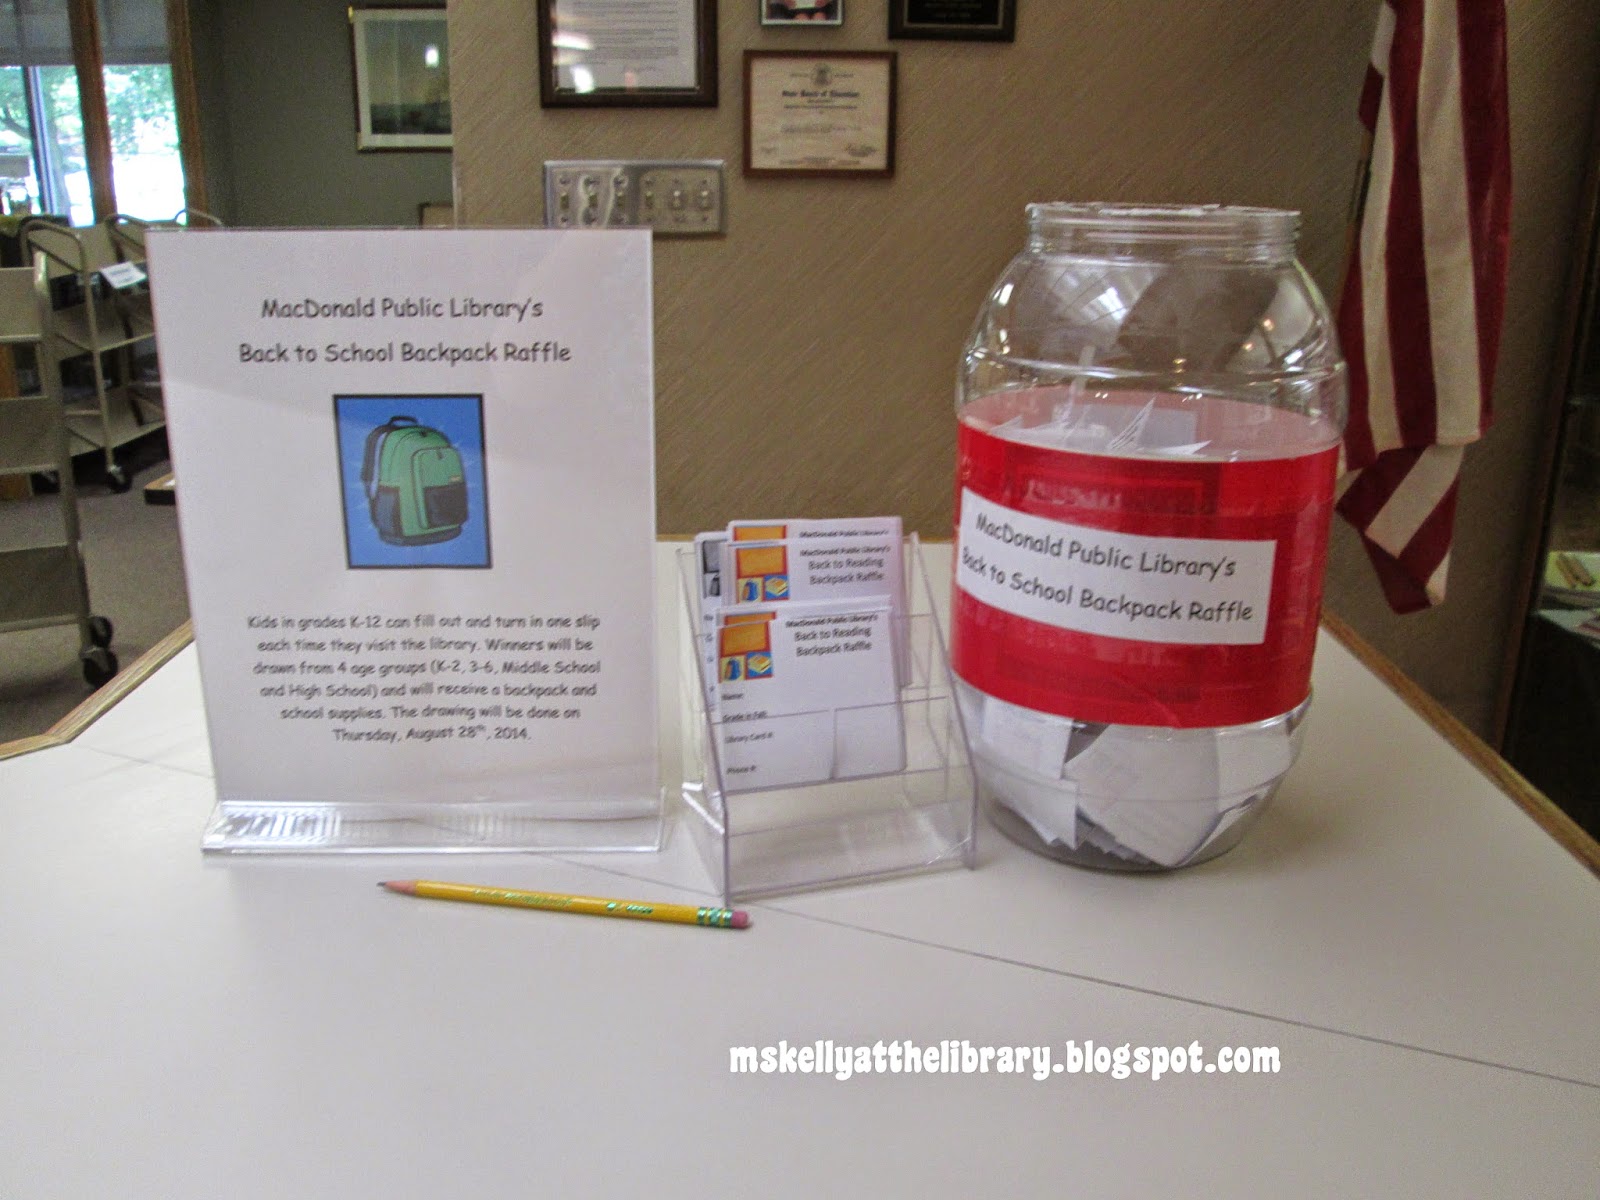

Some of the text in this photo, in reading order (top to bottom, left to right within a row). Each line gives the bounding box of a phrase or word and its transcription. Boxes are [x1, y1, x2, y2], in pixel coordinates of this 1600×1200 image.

[261, 298, 543, 322] MacDonald Public Library's
[239, 342, 572, 366] Back to School Backpack Raffle
[976, 512, 1237, 581] MacDonald Public Library's
[809, 558, 884, 570] Back to Reading
[810, 571, 884, 585] Backpack Raffle
[963, 546, 1253, 622] Back to School Backpack Raffle
[248, 614, 601, 632] Kids in grades K-12 can fill out and turn in one slip
[795, 627, 871, 641] Back to Reading
[258, 637, 592, 654] each time they visit the library. Winners will be
[796, 640, 872, 657] Backpack Raffle
[253, 660, 601, 677] drawn from 4 age groups (K-2, 3-6, Middle School
[261, 683, 596, 699] and High School) and will receive a backpack and
[281, 706, 580, 721] school supplies. The drawing will be done on
[332, 729, 402, 742] Thursday,
[406, 728, 452, 741] August
[494, 728, 532, 739] 2014.
